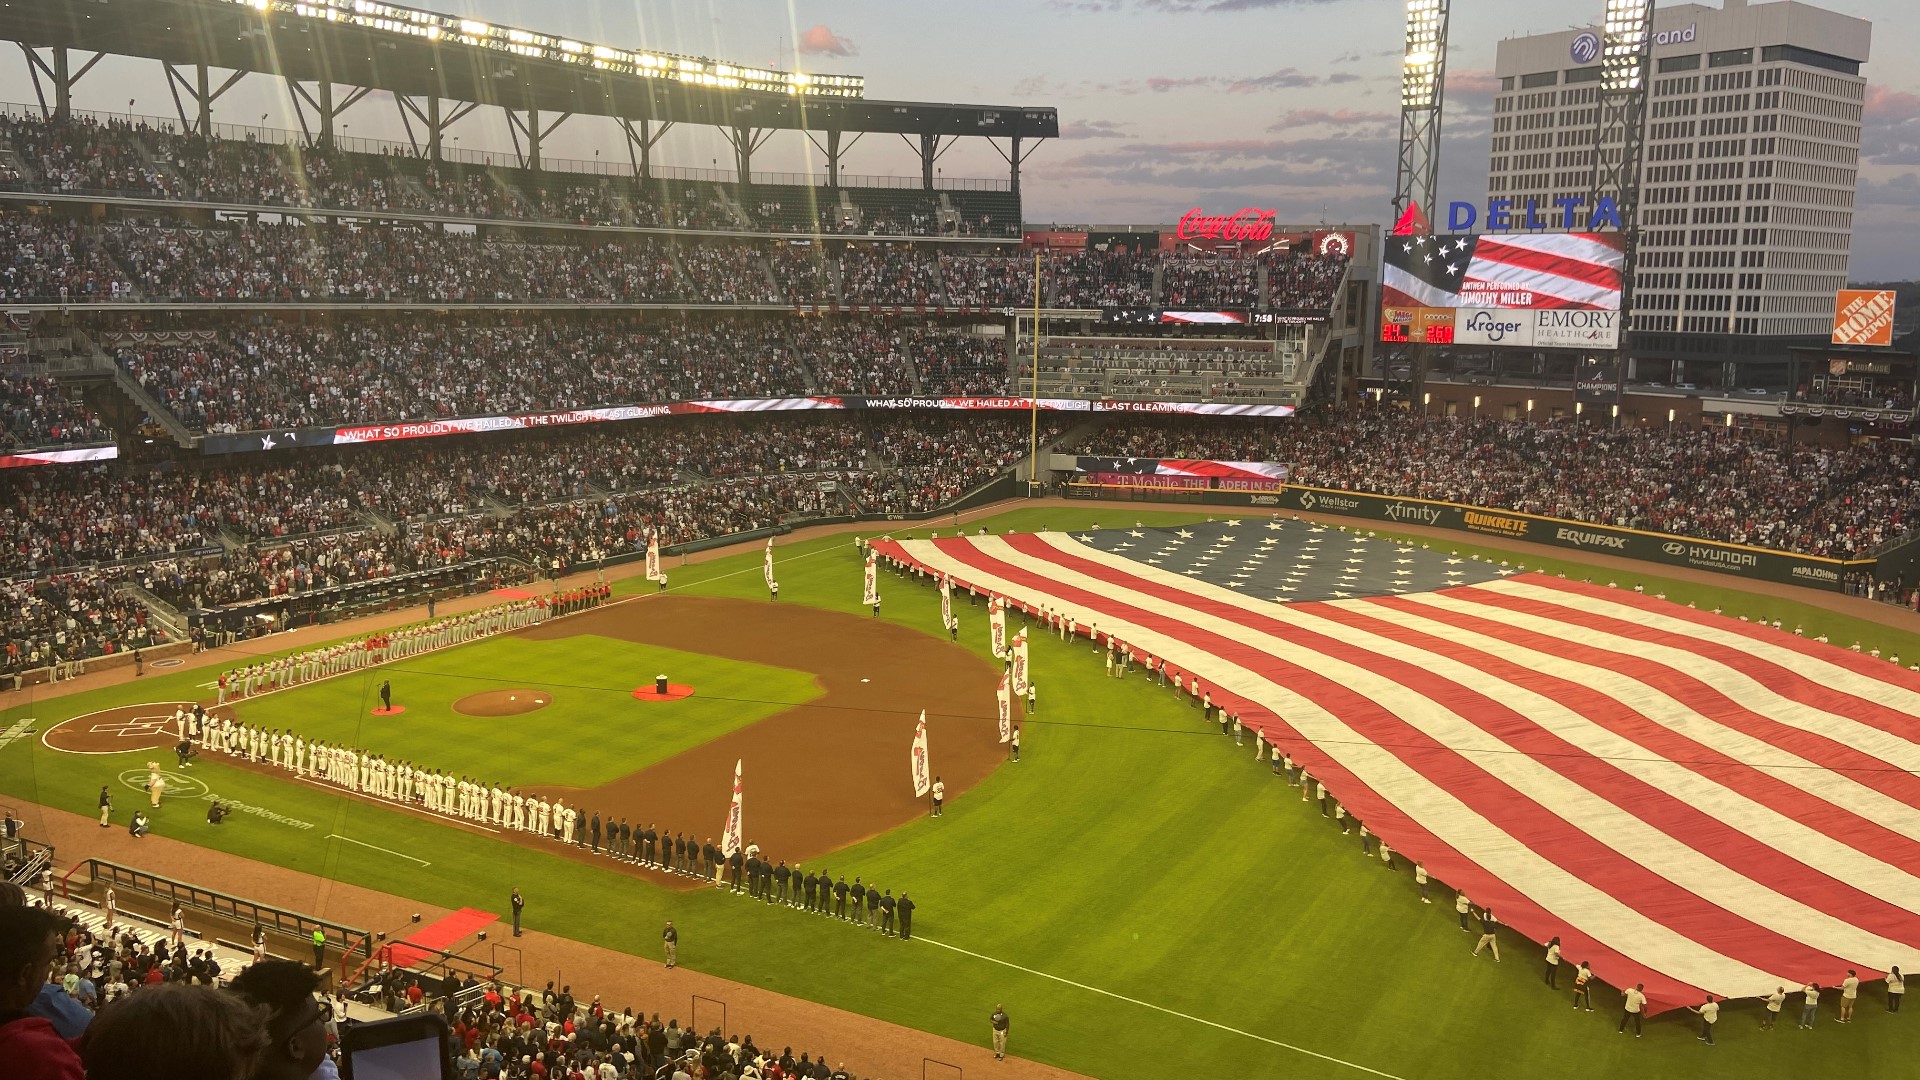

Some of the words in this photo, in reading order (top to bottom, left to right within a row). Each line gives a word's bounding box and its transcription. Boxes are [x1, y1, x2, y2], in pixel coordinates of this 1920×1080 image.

[1448, 196, 1623, 231] DELTA
[1177, 207, 1279, 241] Coca-Cola
[1462, 281, 1485, 290] ANTHEM
[1486, 281, 1520, 290] PERFORMED
[1460, 291, 1498, 304] TIMOTHY
[1500, 292, 1533, 305] MILLER
[1841, 296, 1866, 317] THE
[1002, 306, 1015, 316] 42
[1254, 314, 1273, 323] 7:58
[1538, 310, 1617, 329] EMORY
[1833, 291, 1894, 344] HOME
[1466, 311, 1522, 342] Kroger
[1537, 329, 1612, 340] HEALTHCARE
[1855, 311, 1893, 345] DEPOT
[1092, 351, 1130, 368] HANK
[1137, 352, 1188, 369] AARON
[1196, 353, 1267, 371] TERRACE
[1576, 381, 1617, 392] CHAMPIONS
[866, 399, 896, 408] WHAT
[898, 399, 911, 408] SO
[913, 400, 957, 408] PROUDLY
[959, 400, 975, 408] WE
[976, 400, 1011, 408] HAILED
[1012, 400, 1024, 408] AT
[1105, 402, 1131, 411] LAST
[344, 428, 380, 441] WHAT
[383, 427, 400, 438] SO
[402, 423, 453, 436] PROUDLY
[455, 421, 474, 431] WE
[475, 417, 512, 429] HAILED
[514, 417, 527, 427] AT
[528, 415, 549, 425] THE
[603, 409, 626, 419] LAST
[1184, 478, 1204, 489] THE
[1206, 479, 1248, 490] LADER
[1250, 481, 1263, 491] IN
[1319, 495, 1360, 508] Wellstar
[1384, 501, 1441, 525] xfinity
[1463, 511, 1528, 532] QUIKRETE
[1556, 528, 1625, 549] EQUIFAX
[1688, 557, 1741, 571] HyundaiUSA.com
[1689, 546, 1756, 566] HYUNDAI
[1792, 566, 1812, 576] PAPA
